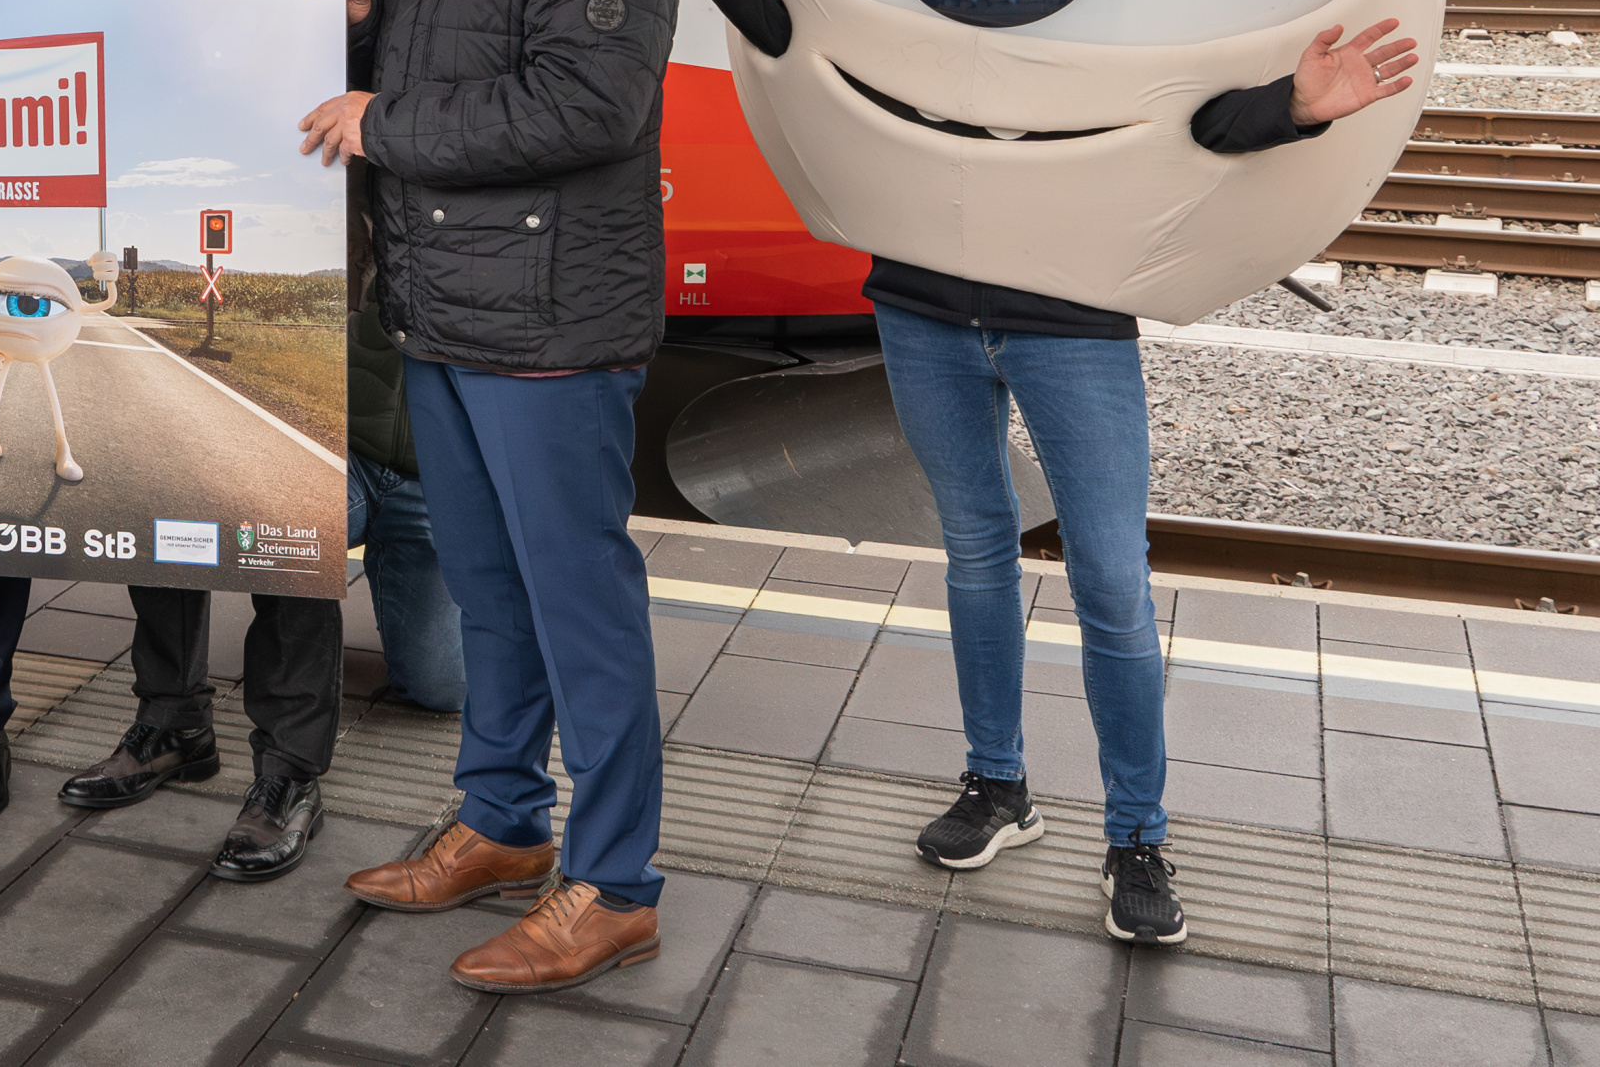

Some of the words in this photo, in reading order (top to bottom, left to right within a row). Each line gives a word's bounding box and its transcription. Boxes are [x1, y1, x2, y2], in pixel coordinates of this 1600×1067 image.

[679, 292, 711, 306] HLL
[260, 523, 283, 537] Das
[287, 525, 317, 539] Land
[83, 529, 137, 560] StB
[257, 542, 318, 557] Steiermark
[247, 558, 275, 567] Verkehr
